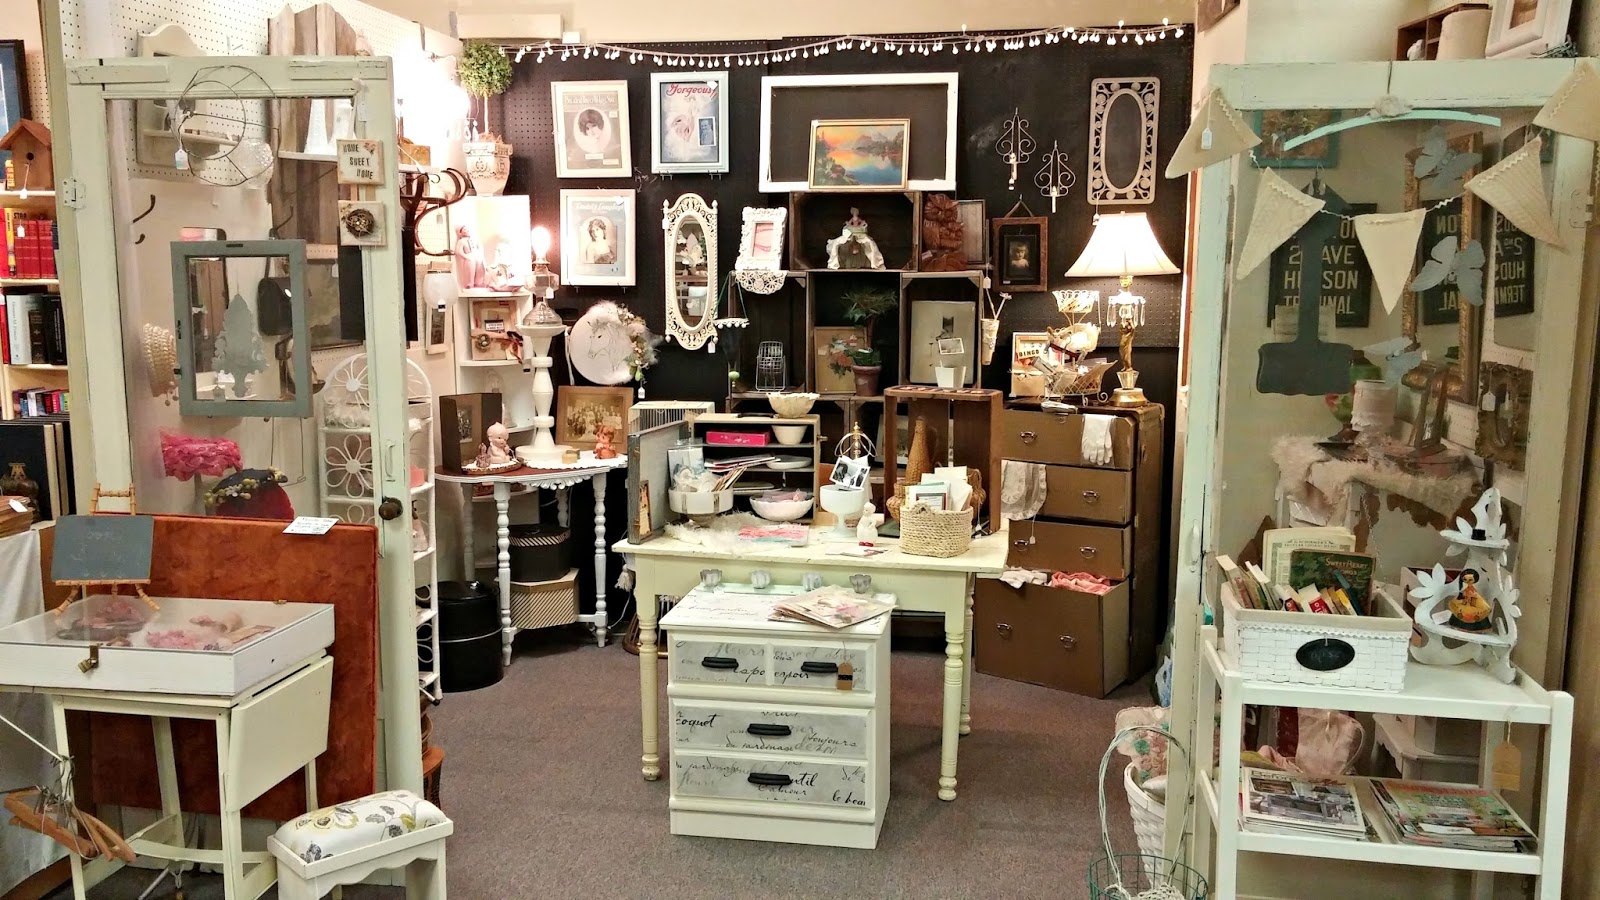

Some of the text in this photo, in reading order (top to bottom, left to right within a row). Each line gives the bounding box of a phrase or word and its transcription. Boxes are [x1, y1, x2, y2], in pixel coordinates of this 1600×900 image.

[343, 144, 359, 152] HOME
[350, 157, 369, 166] SWEET
[357, 169, 373, 179] HOME
[1321, 245, 1356, 264] AVE
[1284, 270, 1358, 289] HSON
[1018, 349, 1040, 357] BINGO
